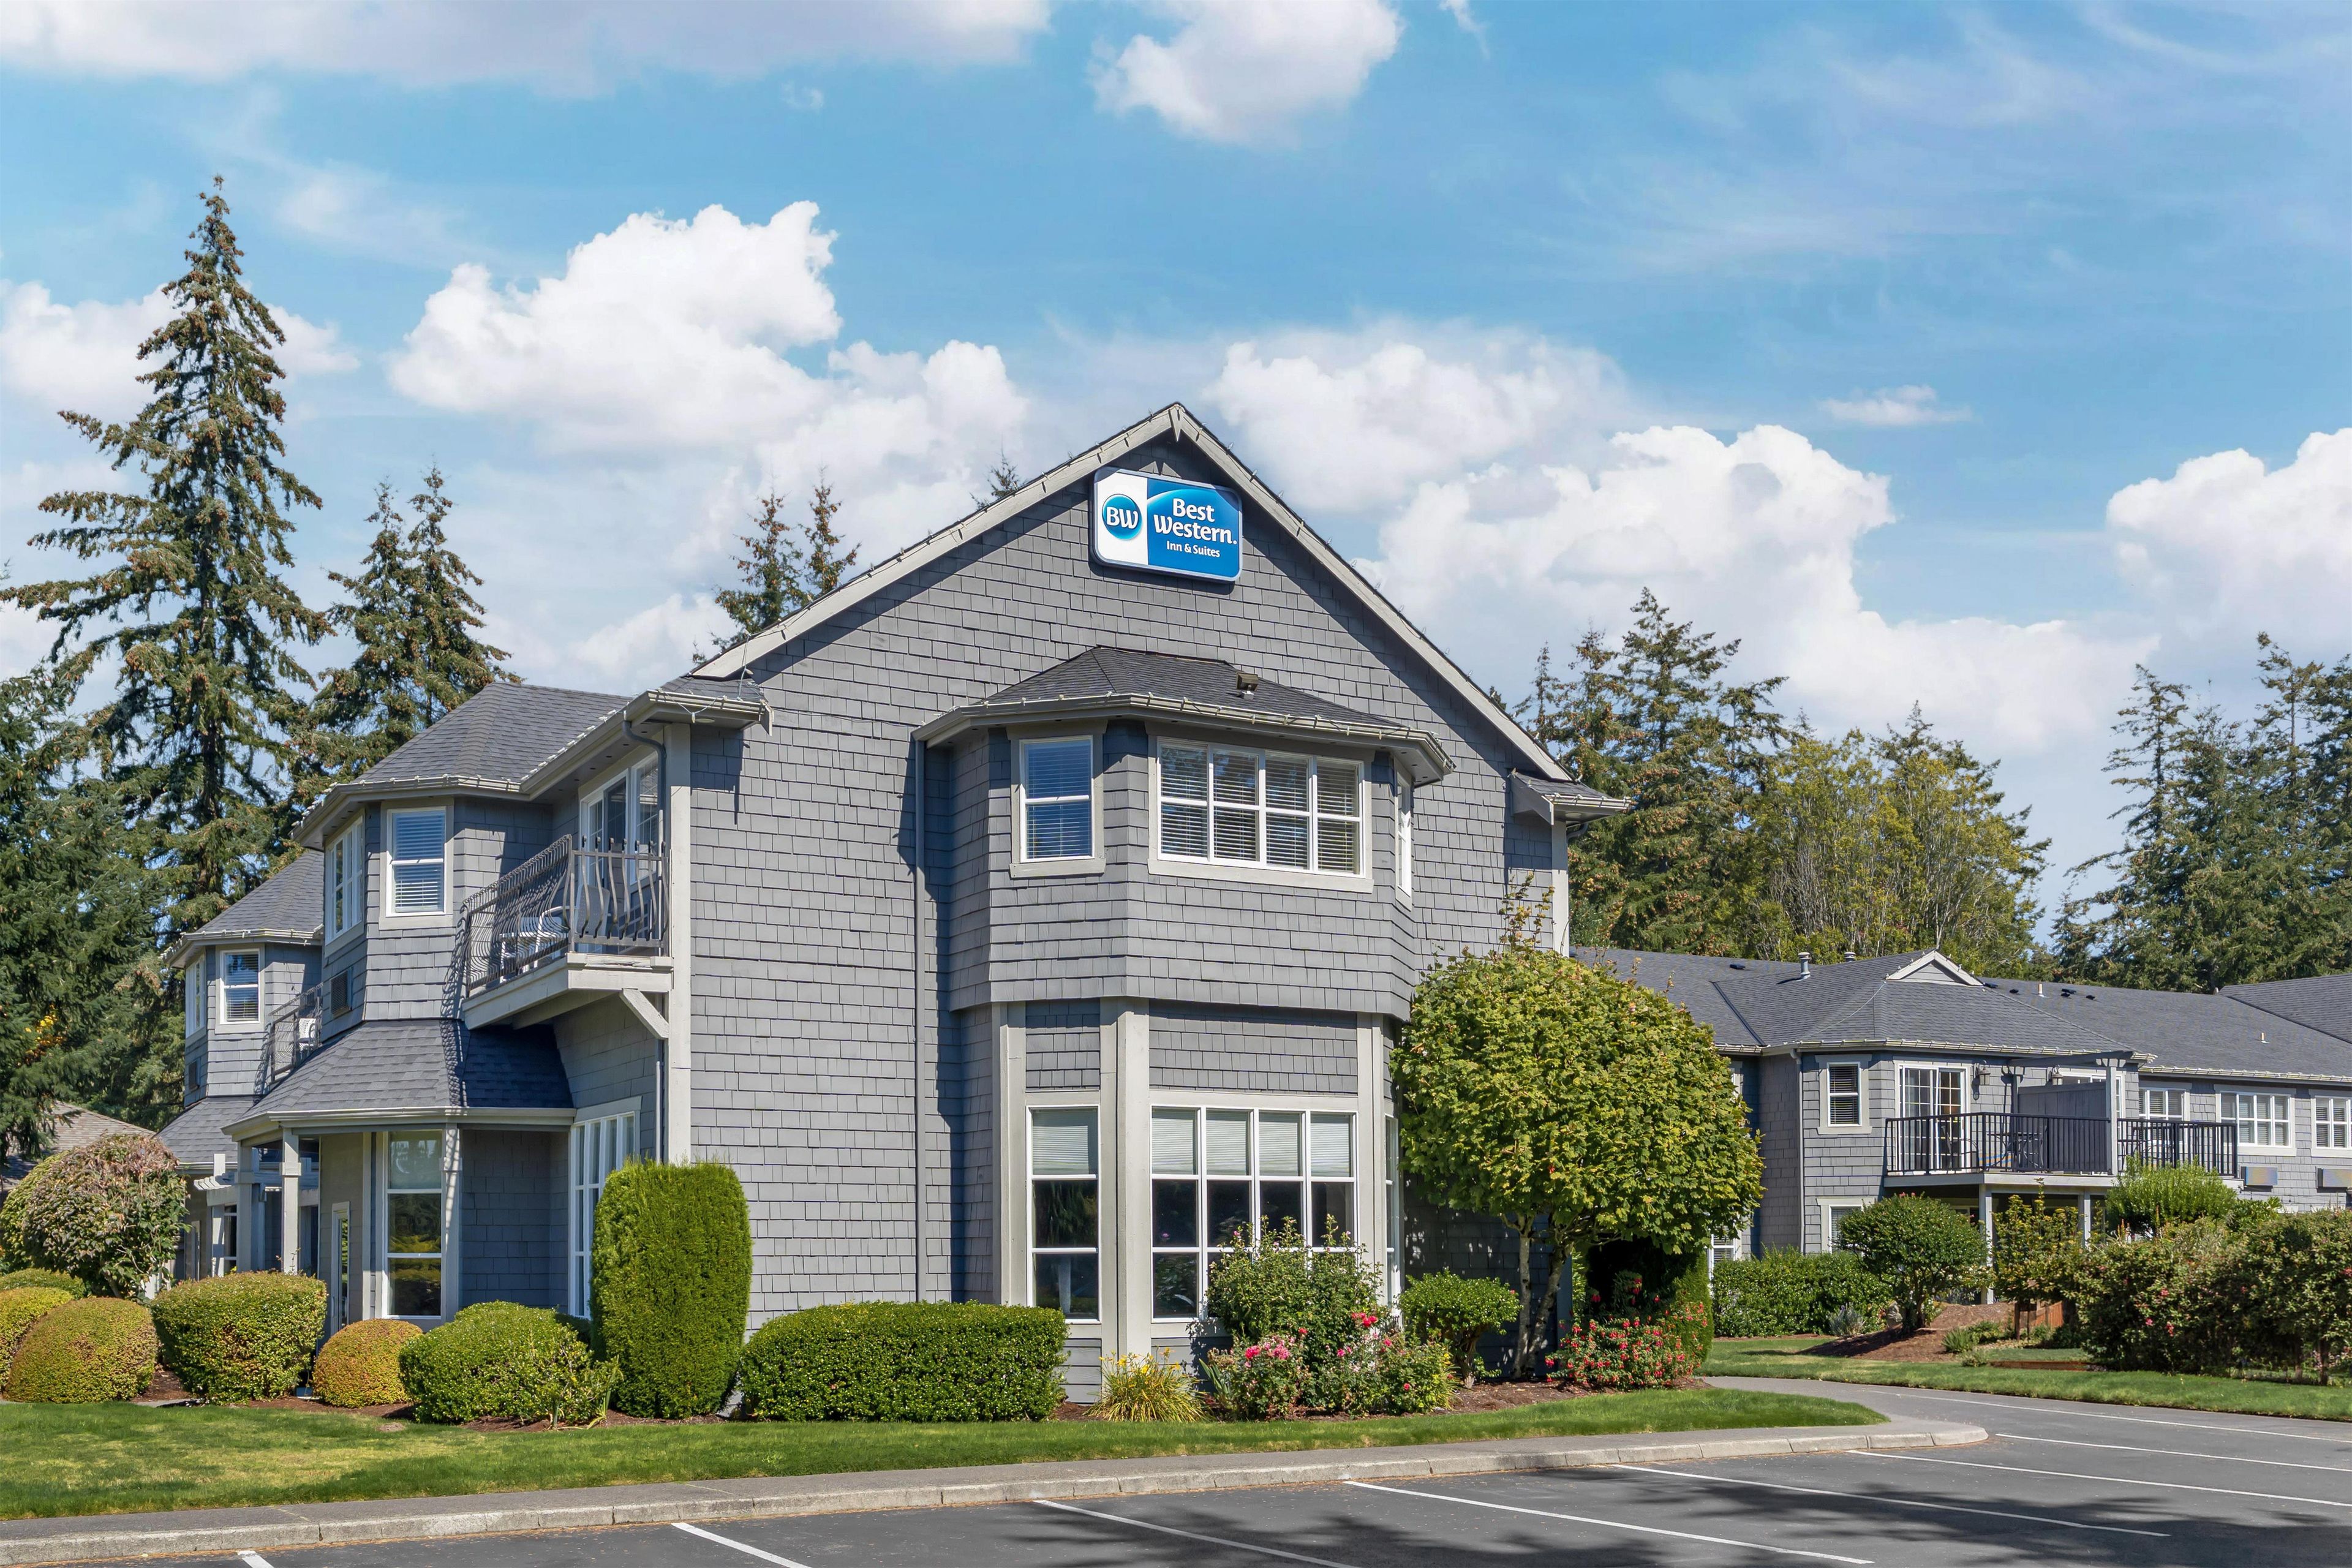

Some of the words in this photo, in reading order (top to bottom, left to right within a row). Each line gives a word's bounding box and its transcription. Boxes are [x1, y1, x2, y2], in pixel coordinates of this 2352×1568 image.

[1106, 507, 1139, 529] BW
[1172, 498, 1215, 522] Best
[1167, 541, 1182, 552] Inn
[1185, 544, 1192, 553] &
[1193, 545, 1220, 557] Suites
